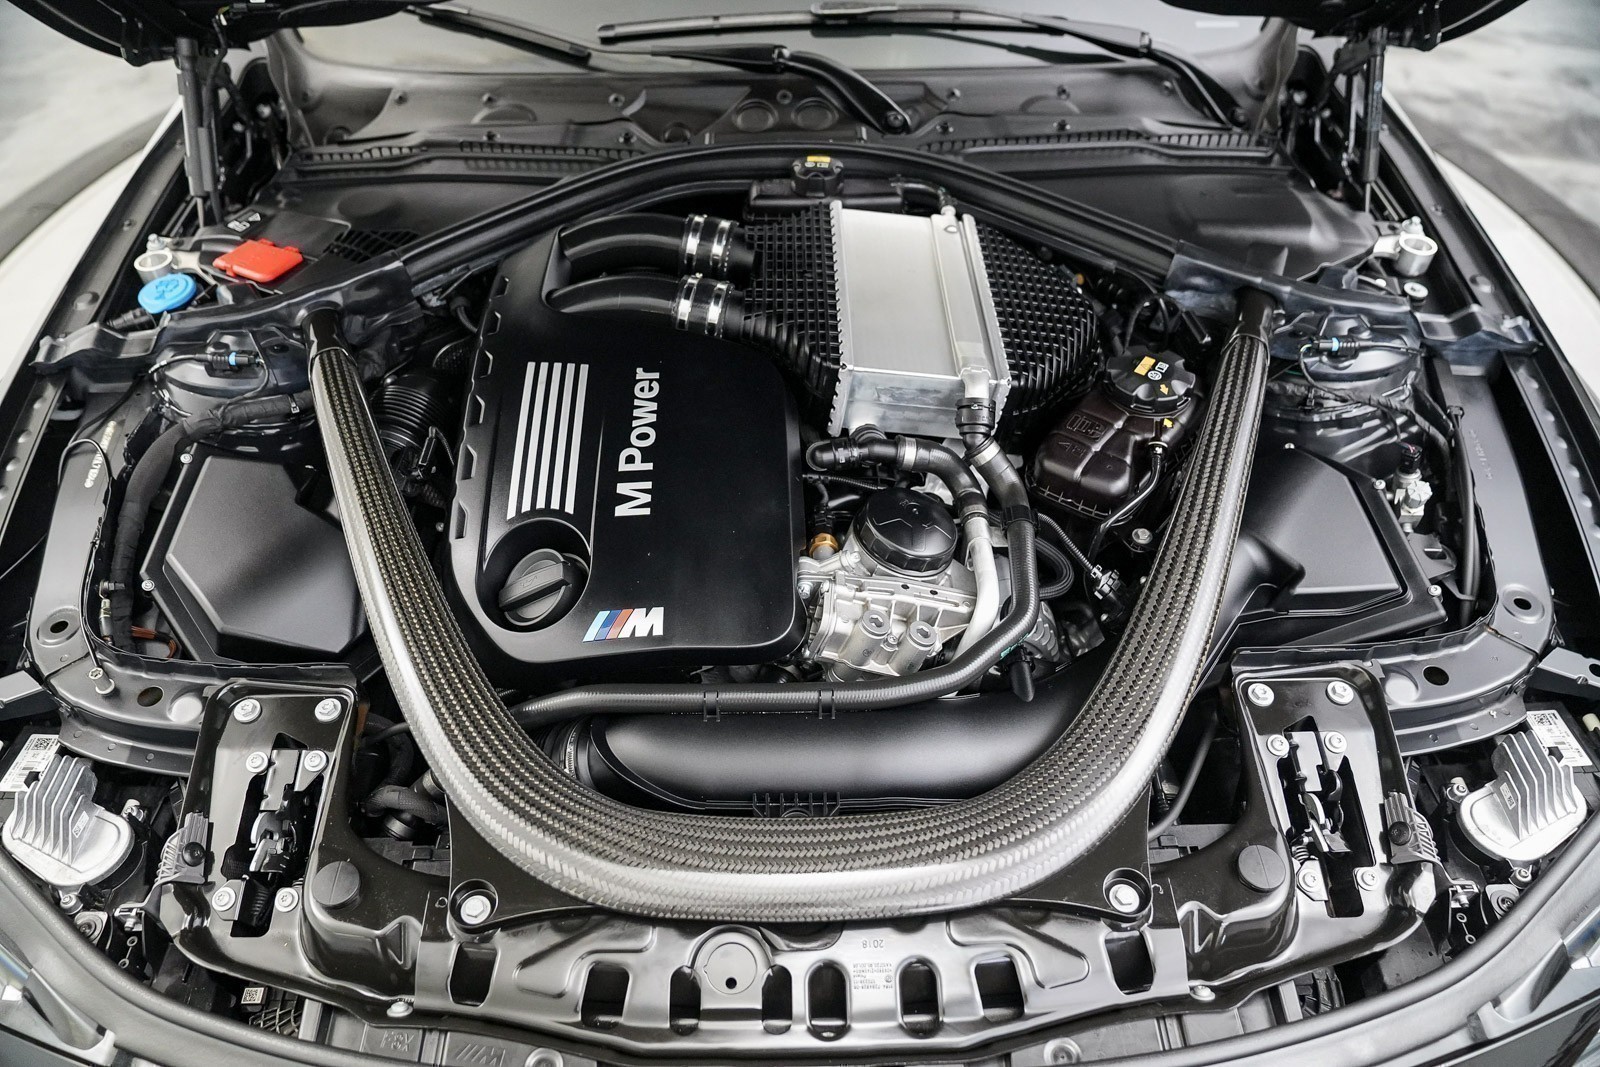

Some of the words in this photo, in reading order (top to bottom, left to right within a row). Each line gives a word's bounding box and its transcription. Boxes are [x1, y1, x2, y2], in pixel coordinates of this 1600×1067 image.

[618, 367, 660, 472] Power
[614, 481, 653, 517] M
[617, 606, 665, 639] M
[861, 939, 884, 949] 2018
